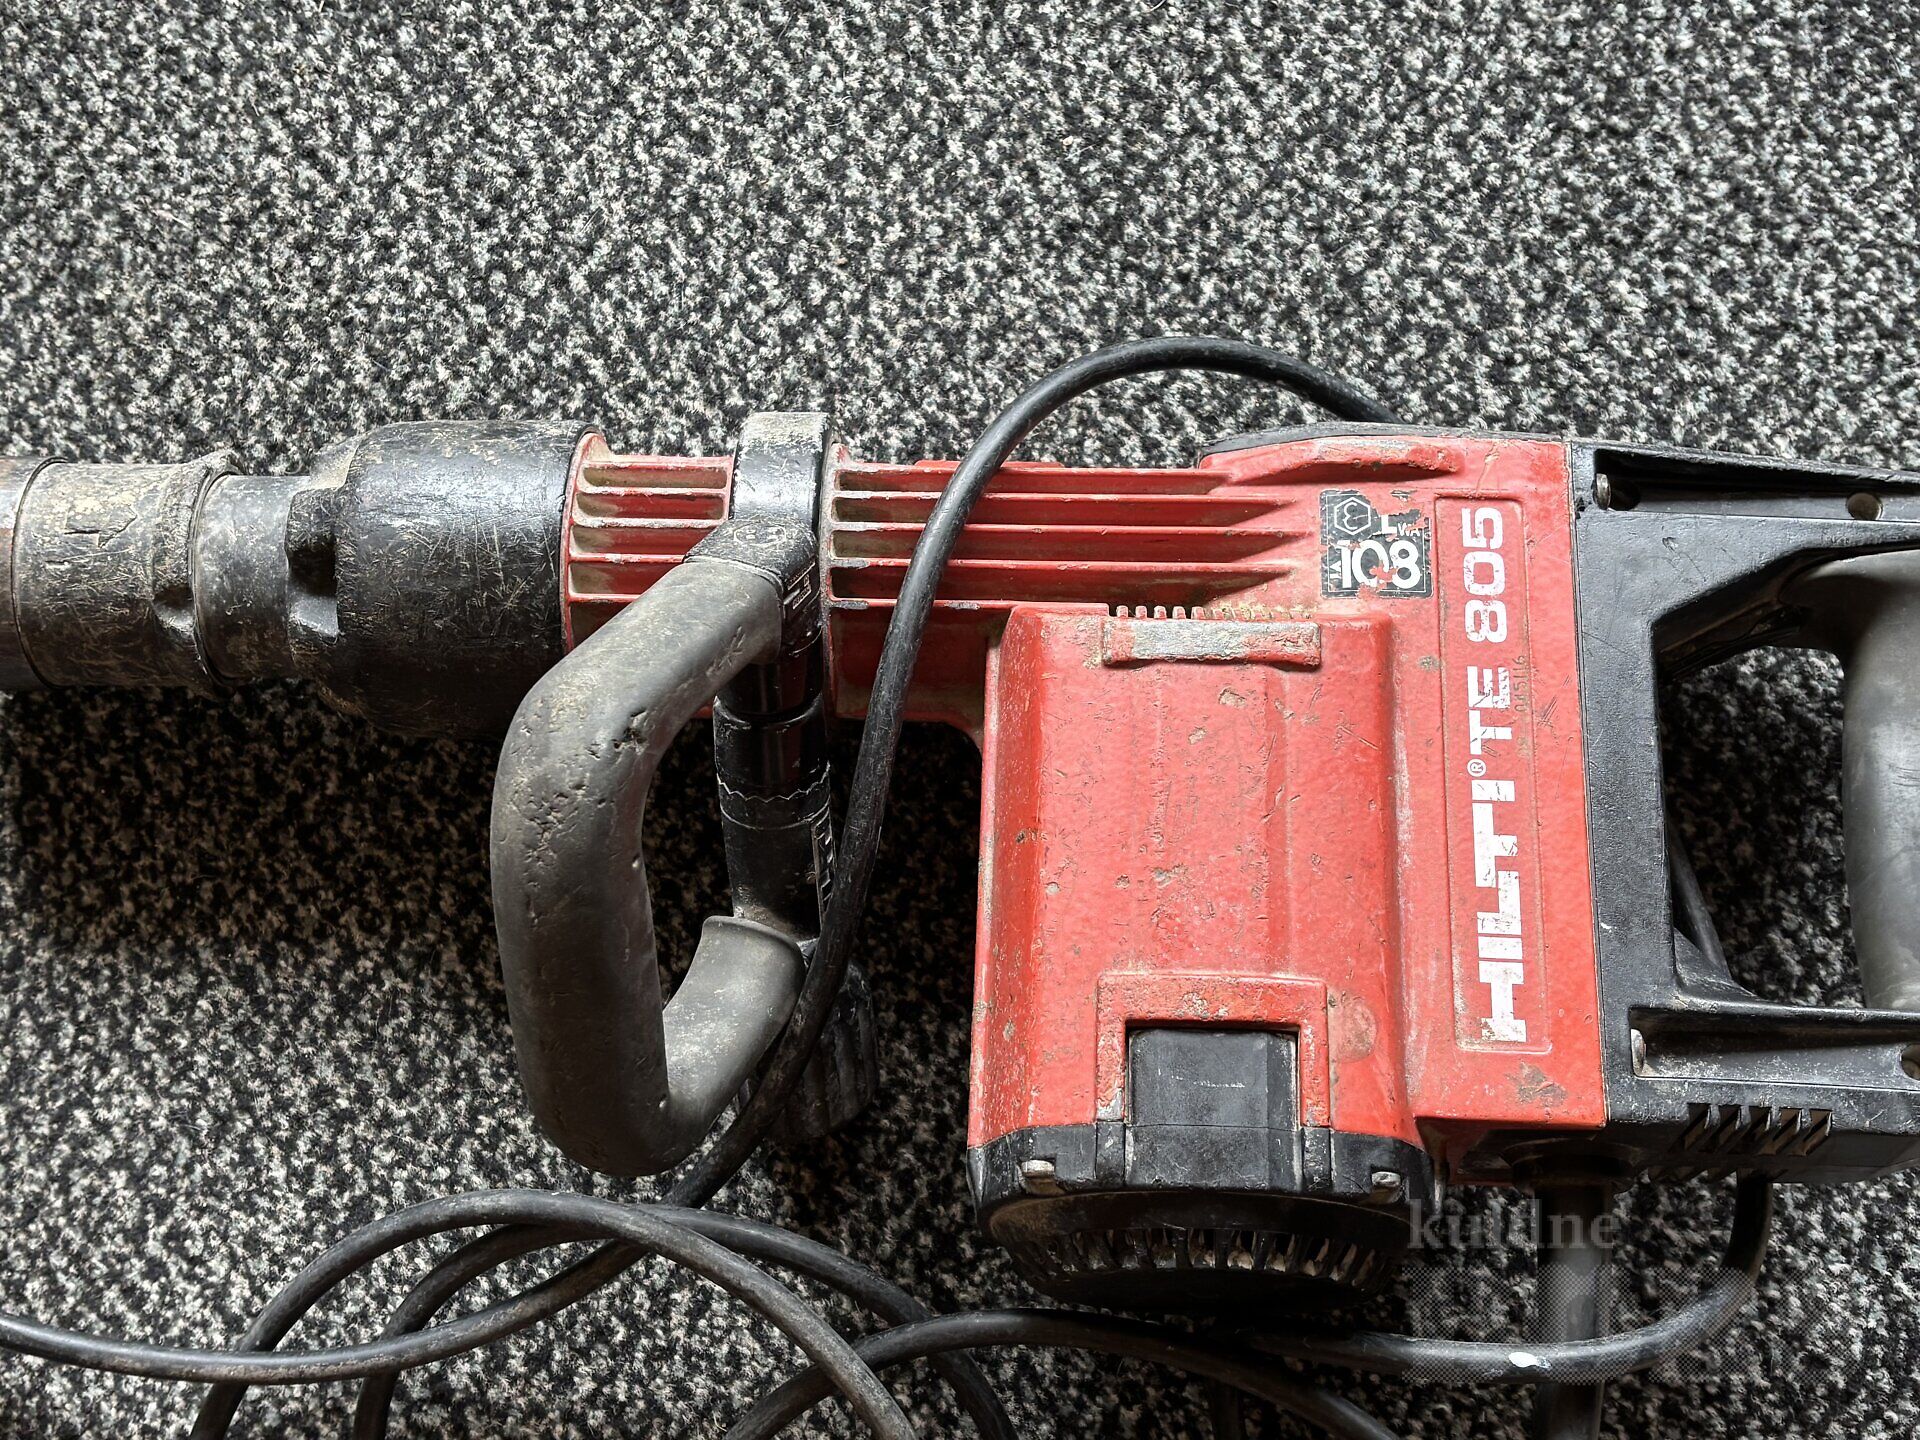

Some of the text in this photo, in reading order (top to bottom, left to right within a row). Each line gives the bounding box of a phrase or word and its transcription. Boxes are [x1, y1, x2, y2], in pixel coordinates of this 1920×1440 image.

[1337, 540, 1421, 589] 108
[1461, 507, 1507, 643] 805
[1467, 666, 1513, 755] TE
